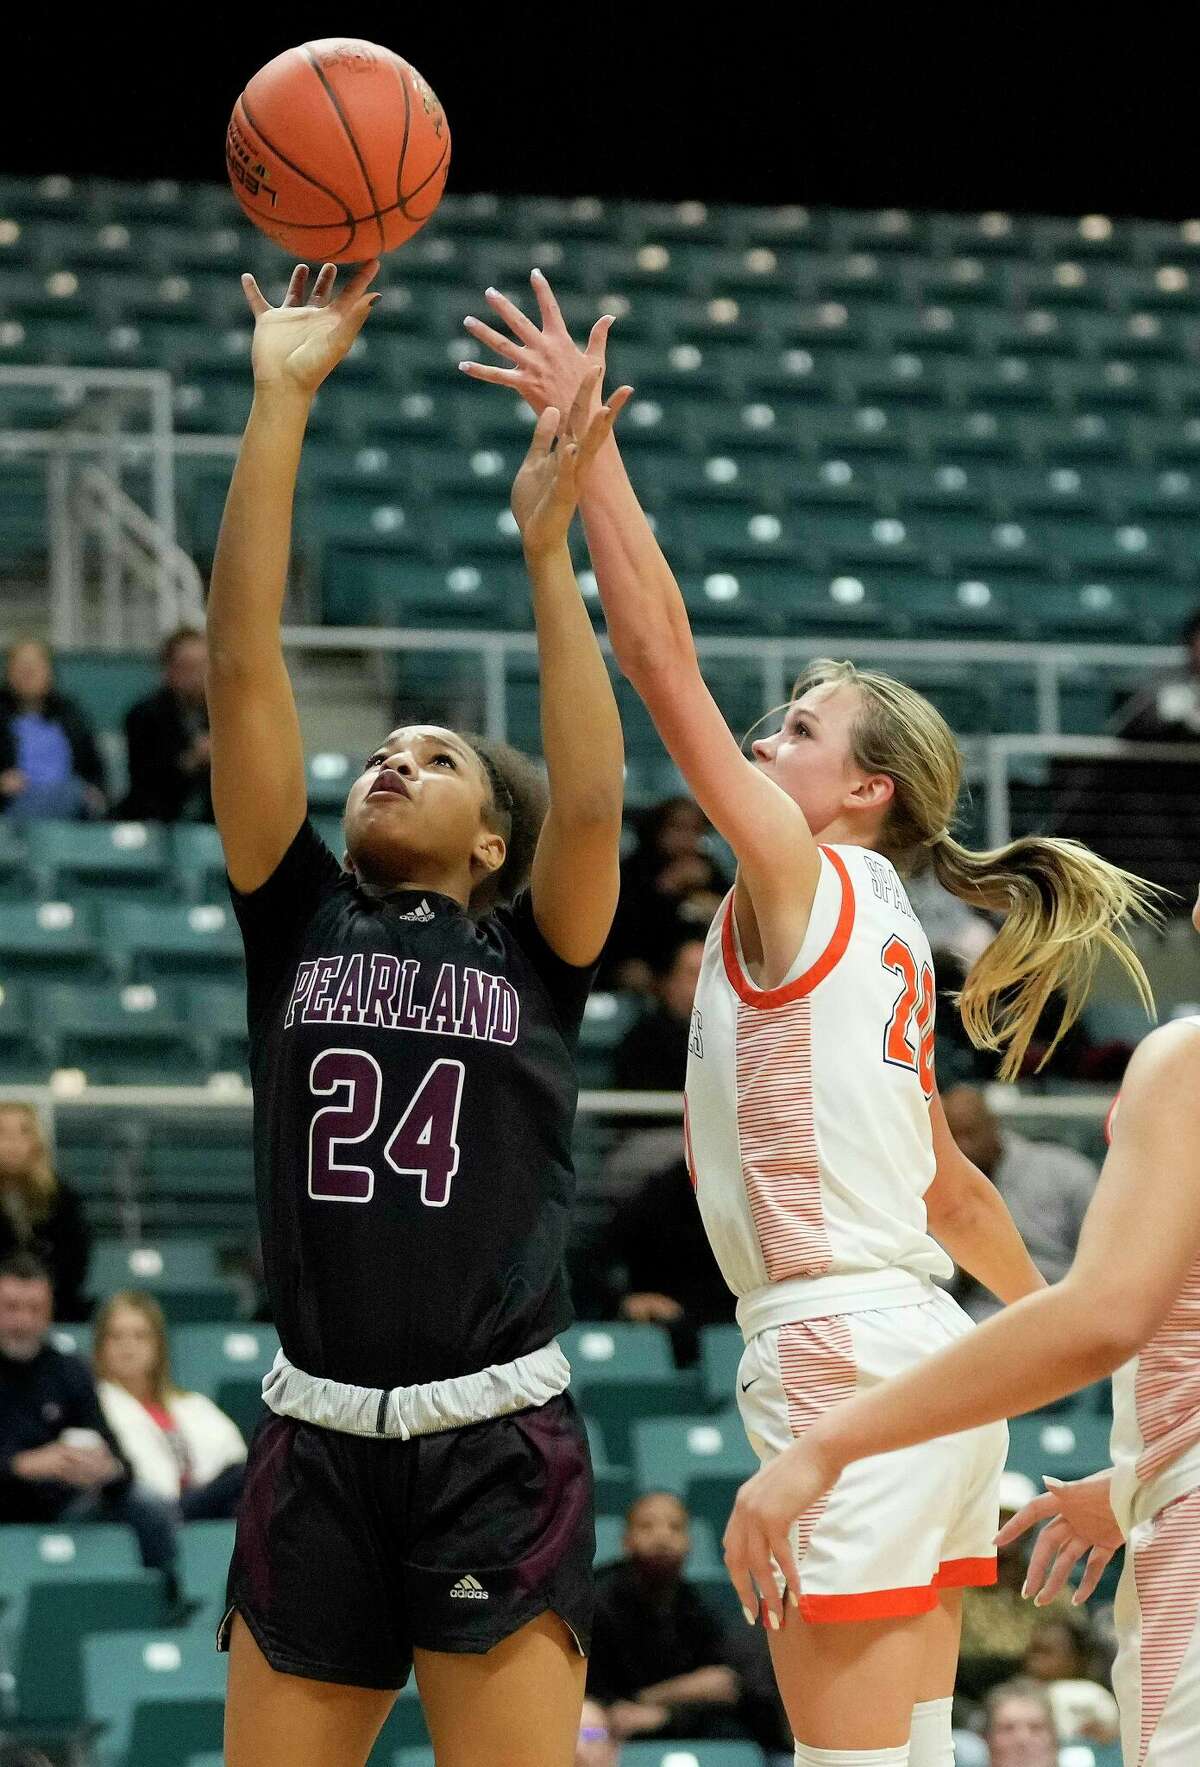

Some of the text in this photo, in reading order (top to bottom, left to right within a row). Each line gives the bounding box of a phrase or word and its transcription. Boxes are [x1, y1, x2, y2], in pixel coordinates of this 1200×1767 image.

[863, 855, 916, 922] SPA
[284, 953, 520, 1046] PEARLAND
[307, 1047, 466, 1208] 24
[449, 1588, 489, 1600] adidas
